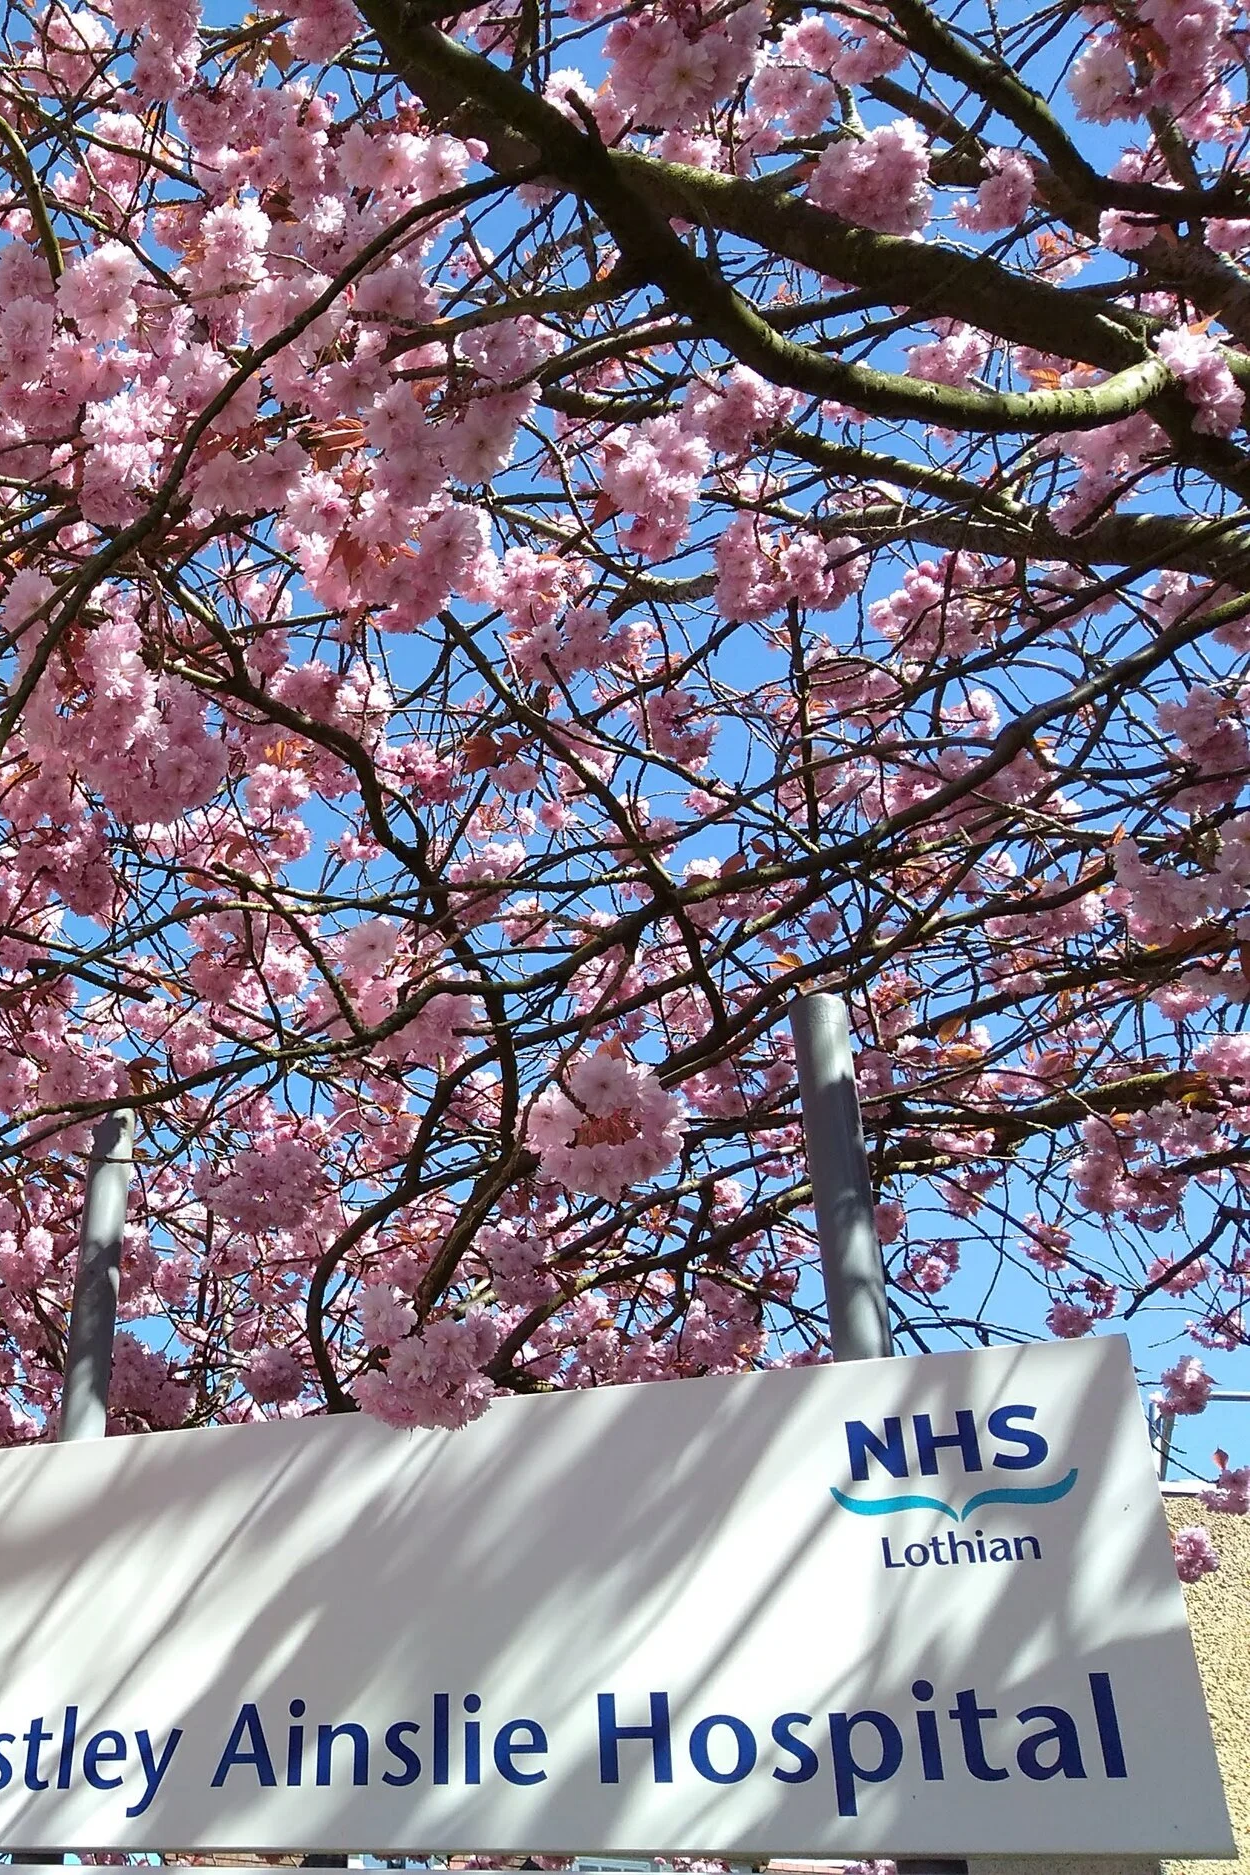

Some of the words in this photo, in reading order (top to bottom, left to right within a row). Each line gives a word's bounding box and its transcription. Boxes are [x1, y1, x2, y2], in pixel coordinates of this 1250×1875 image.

[844, 1404, 1050, 1482] NHS
[881, 1530, 1042, 1569] Lothian
[211, 1693, 548, 1788] Ainslie
[597, 1672, 1128, 1817] Hospital
